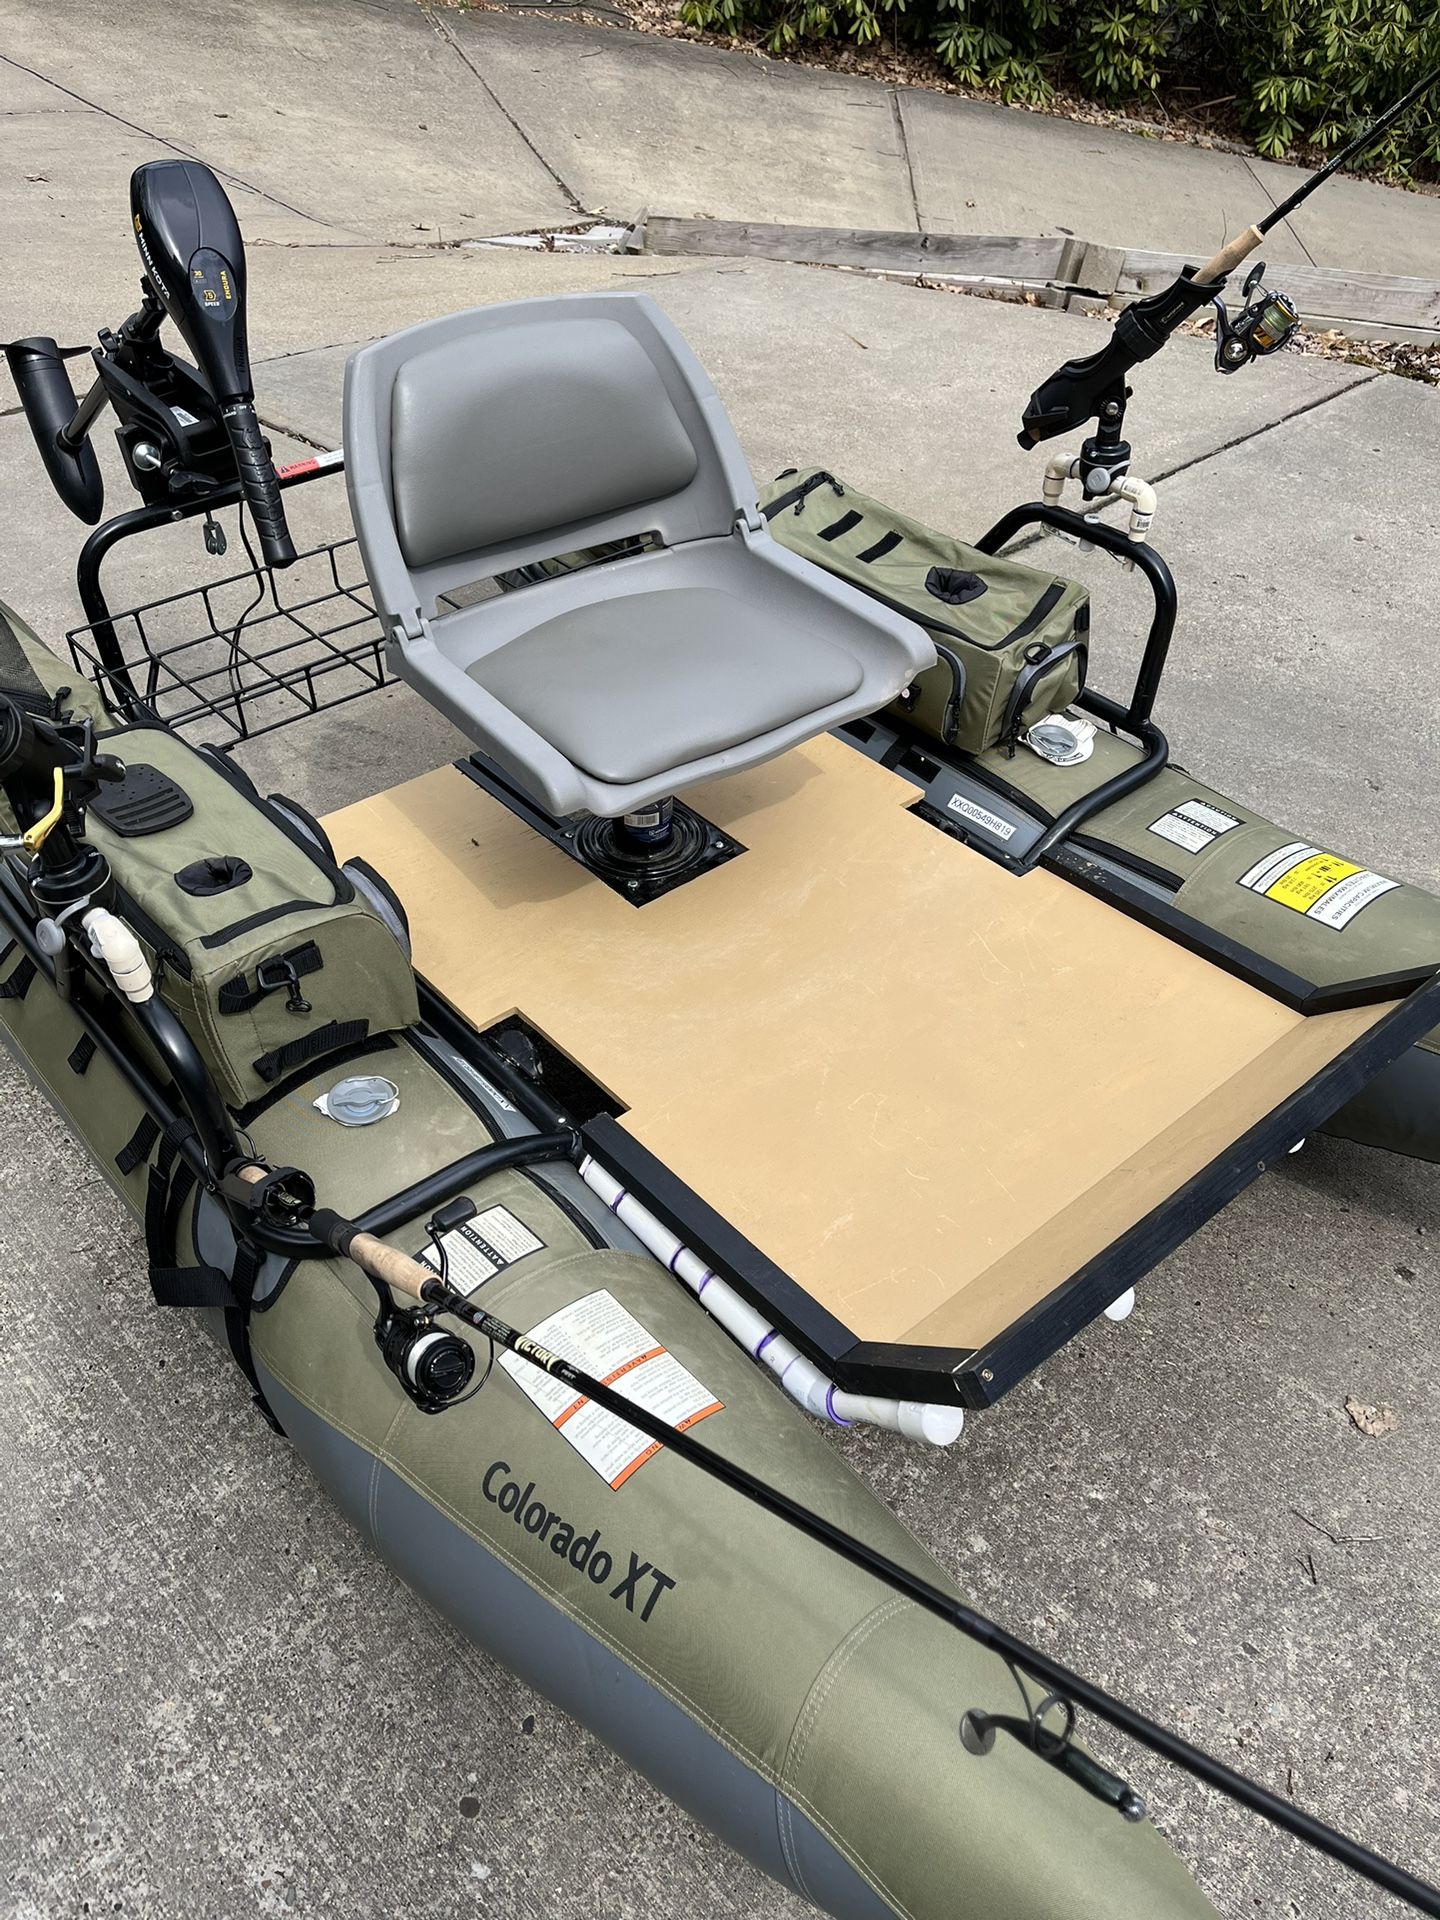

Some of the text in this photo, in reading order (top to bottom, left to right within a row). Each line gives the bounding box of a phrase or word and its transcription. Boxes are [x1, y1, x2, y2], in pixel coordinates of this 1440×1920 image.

[138, 232, 171, 300] MINN KOTA
[220, 270, 232, 300] ENDURA
[1178, 814, 1217, 835] ATTENTION
[1331, 891, 1365, 920] CAPACITIES
[460, 1225, 499, 1262] ATTENTION
[514, 1336, 560, 1372] VICTORY
[482, 1461, 677, 1624] Colorado XT
